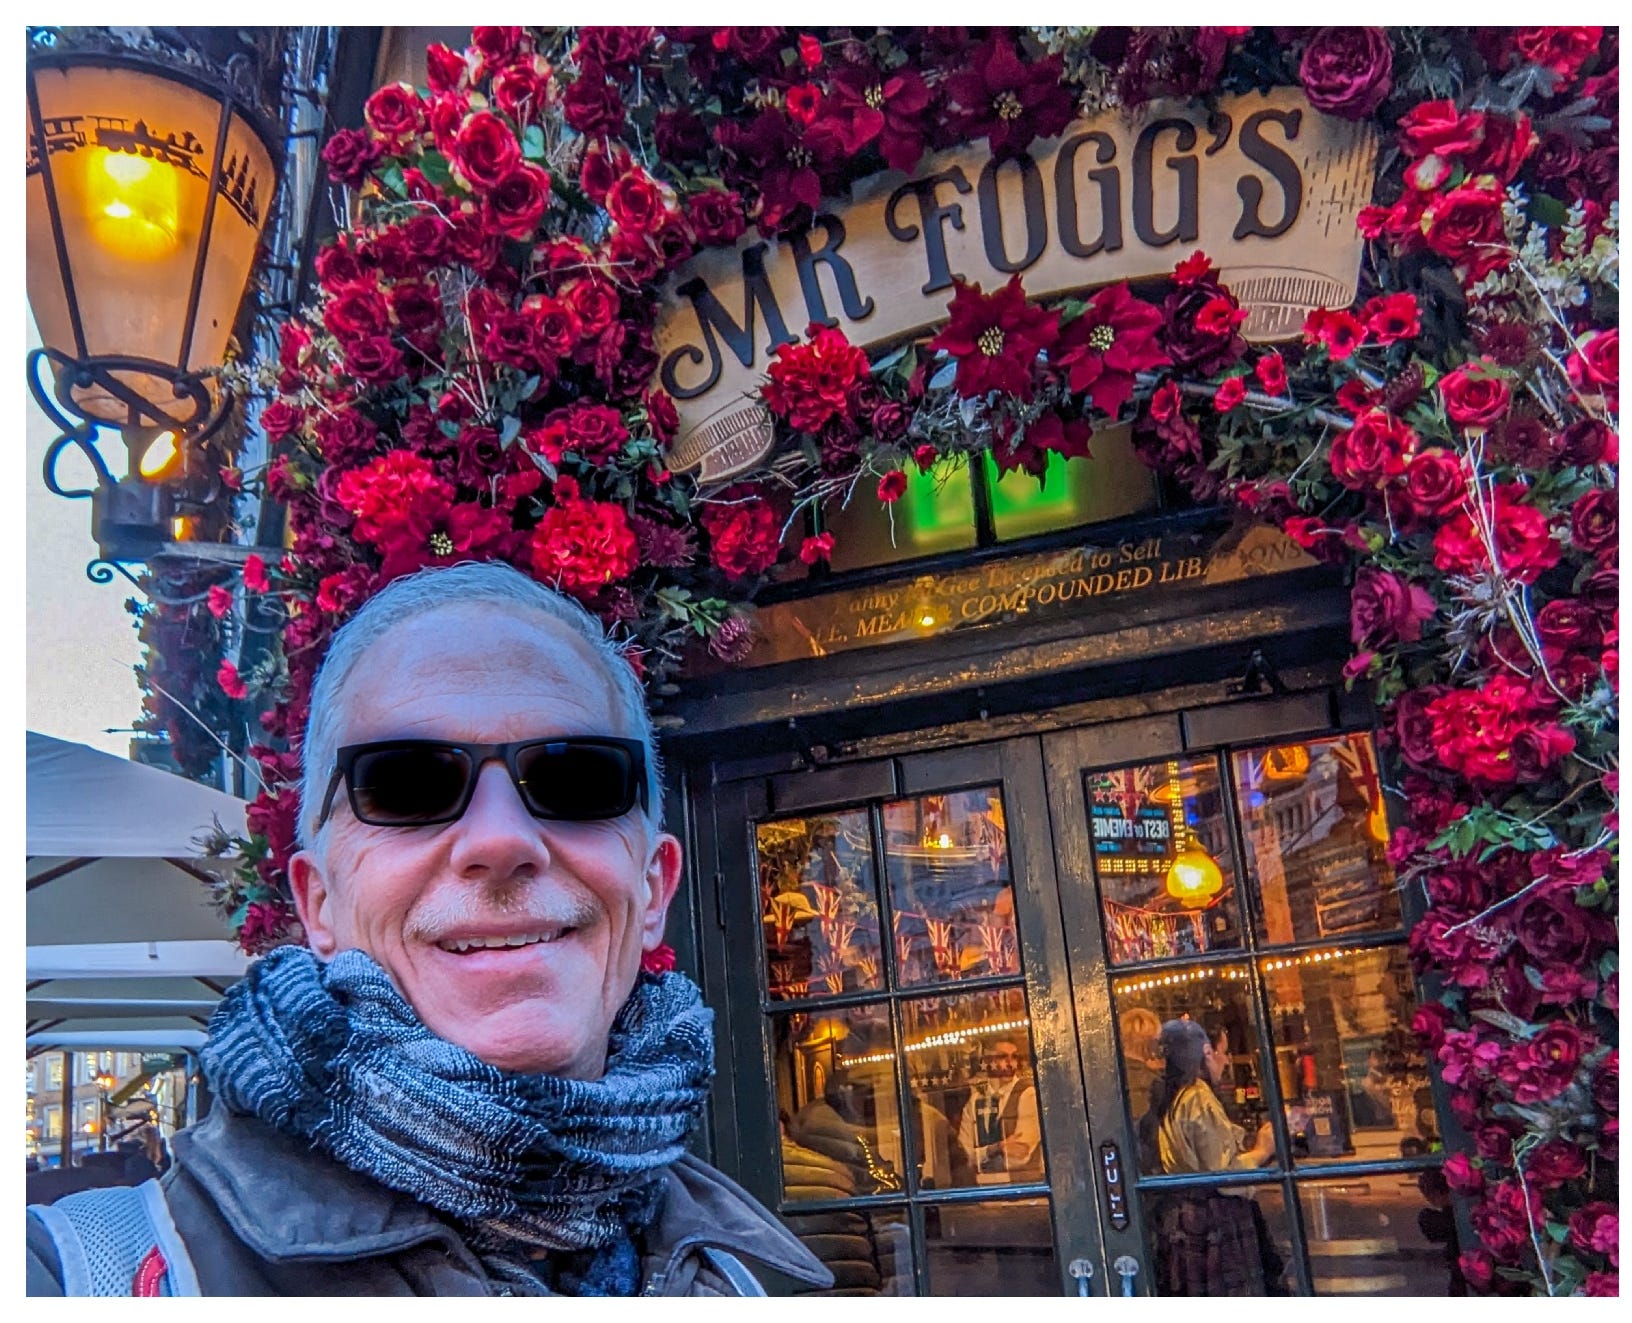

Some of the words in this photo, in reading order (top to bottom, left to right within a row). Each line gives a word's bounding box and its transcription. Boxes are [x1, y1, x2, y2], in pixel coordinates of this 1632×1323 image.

[660, 214, 876, 400] MR
[884, 107, 1305, 296] FOGG'S
[987, 553, 1083, 589] Licensed
[1091, 550, 1112, 569] to
[1119, 537, 1162, 564] Sell
[856, 607, 926, 638] MEA
[961, 566, 1153, 618] COMPOUNDED
[1104, 1151, 1124, 1218] PULL
